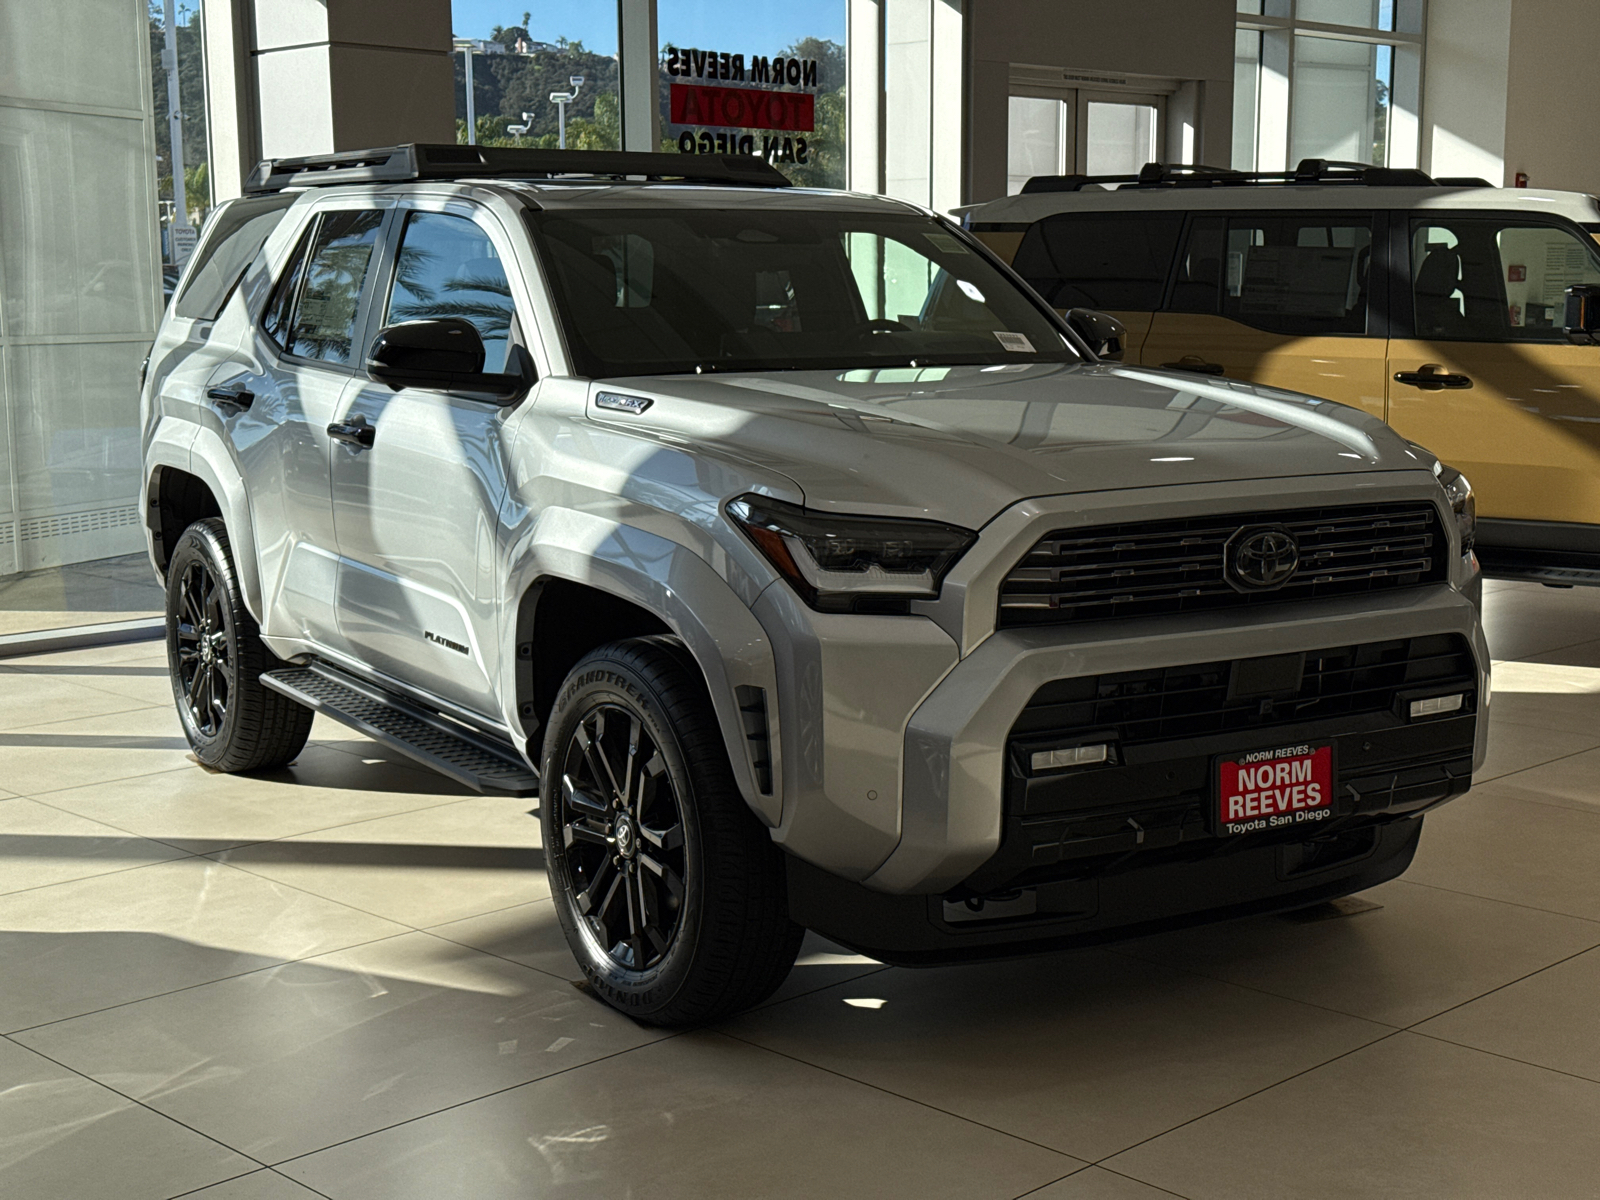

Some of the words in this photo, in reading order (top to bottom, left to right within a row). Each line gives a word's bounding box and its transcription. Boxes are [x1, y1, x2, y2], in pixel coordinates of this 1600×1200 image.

[424, 630, 469, 656] PLATINUM
[558, 669, 650, 712] GRANDTREK
[1245, 750, 1273, 763] NORM
[1275, 744, 1309, 758] REEVES
[1238, 759, 1312, 792] NORM
[1228, 782, 1322, 819] REEVES
[1226, 819, 1266, 834] Toyota
[1269, 815, 1292, 827] San
[1295, 808, 1331, 821] Diego
[582, 964, 654, 1007] DUNLOP
